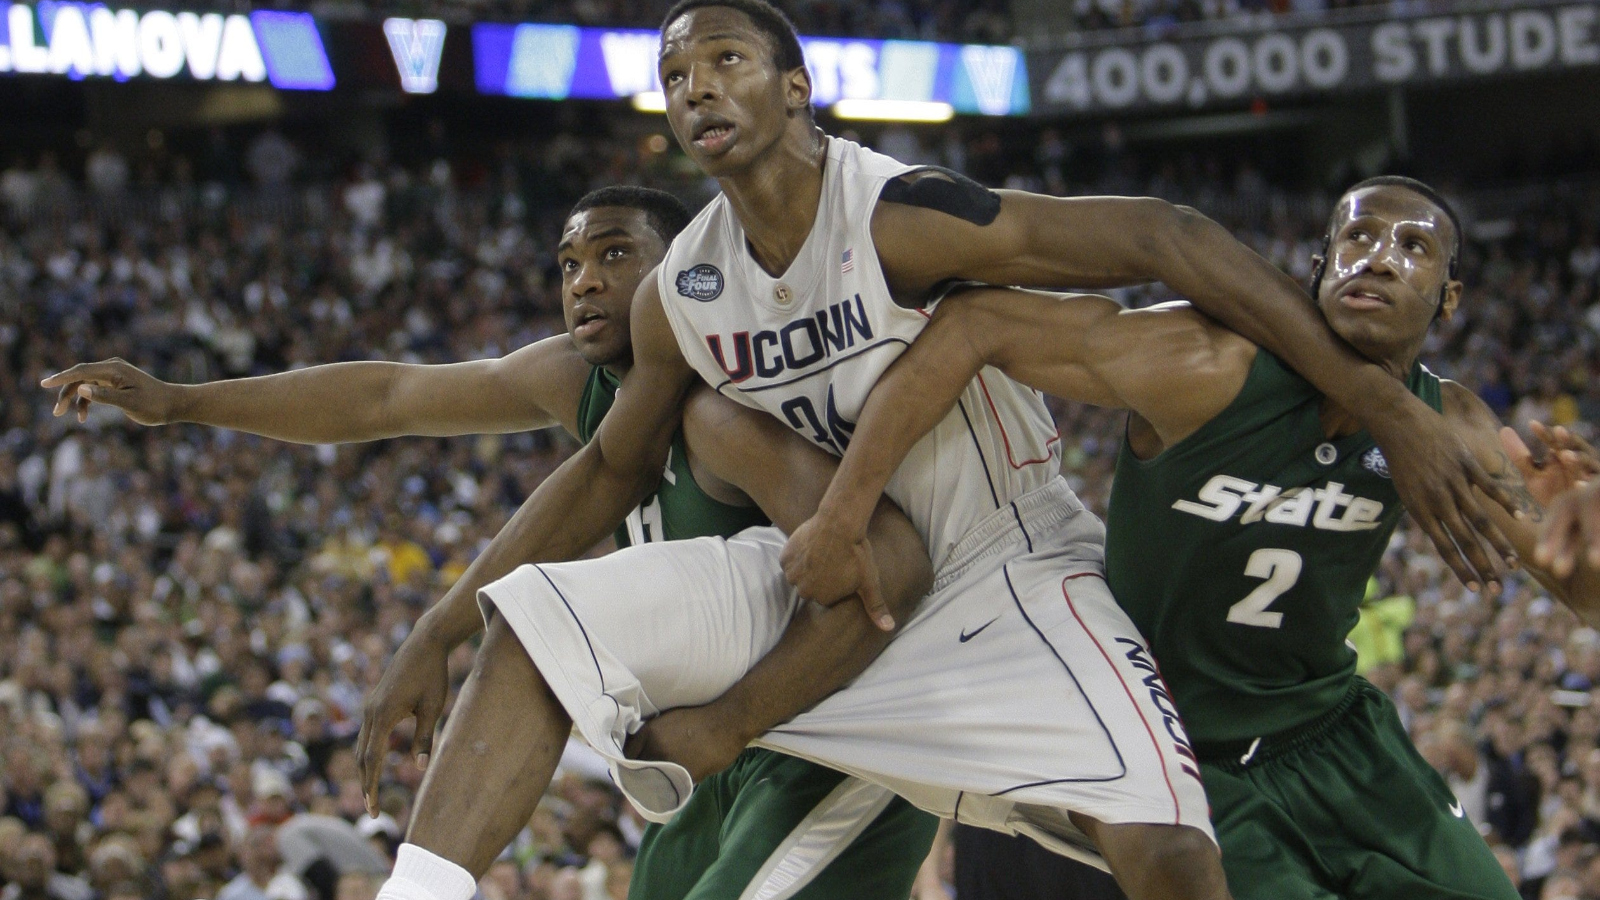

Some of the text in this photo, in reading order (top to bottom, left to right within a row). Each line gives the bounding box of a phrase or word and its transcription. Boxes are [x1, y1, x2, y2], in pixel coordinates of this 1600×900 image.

[0, 4, 267, 82] LANOVA
[1043, 6, 1600, 109] 400,000 STUDE
[688, 279, 717, 291] FOUR
[696, 273, 717, 282] FINAL
[705, 293, 874, 383] UCONN
[1171, 474, 1384, 532] State
[1226, 548, 1303, 629] 2
